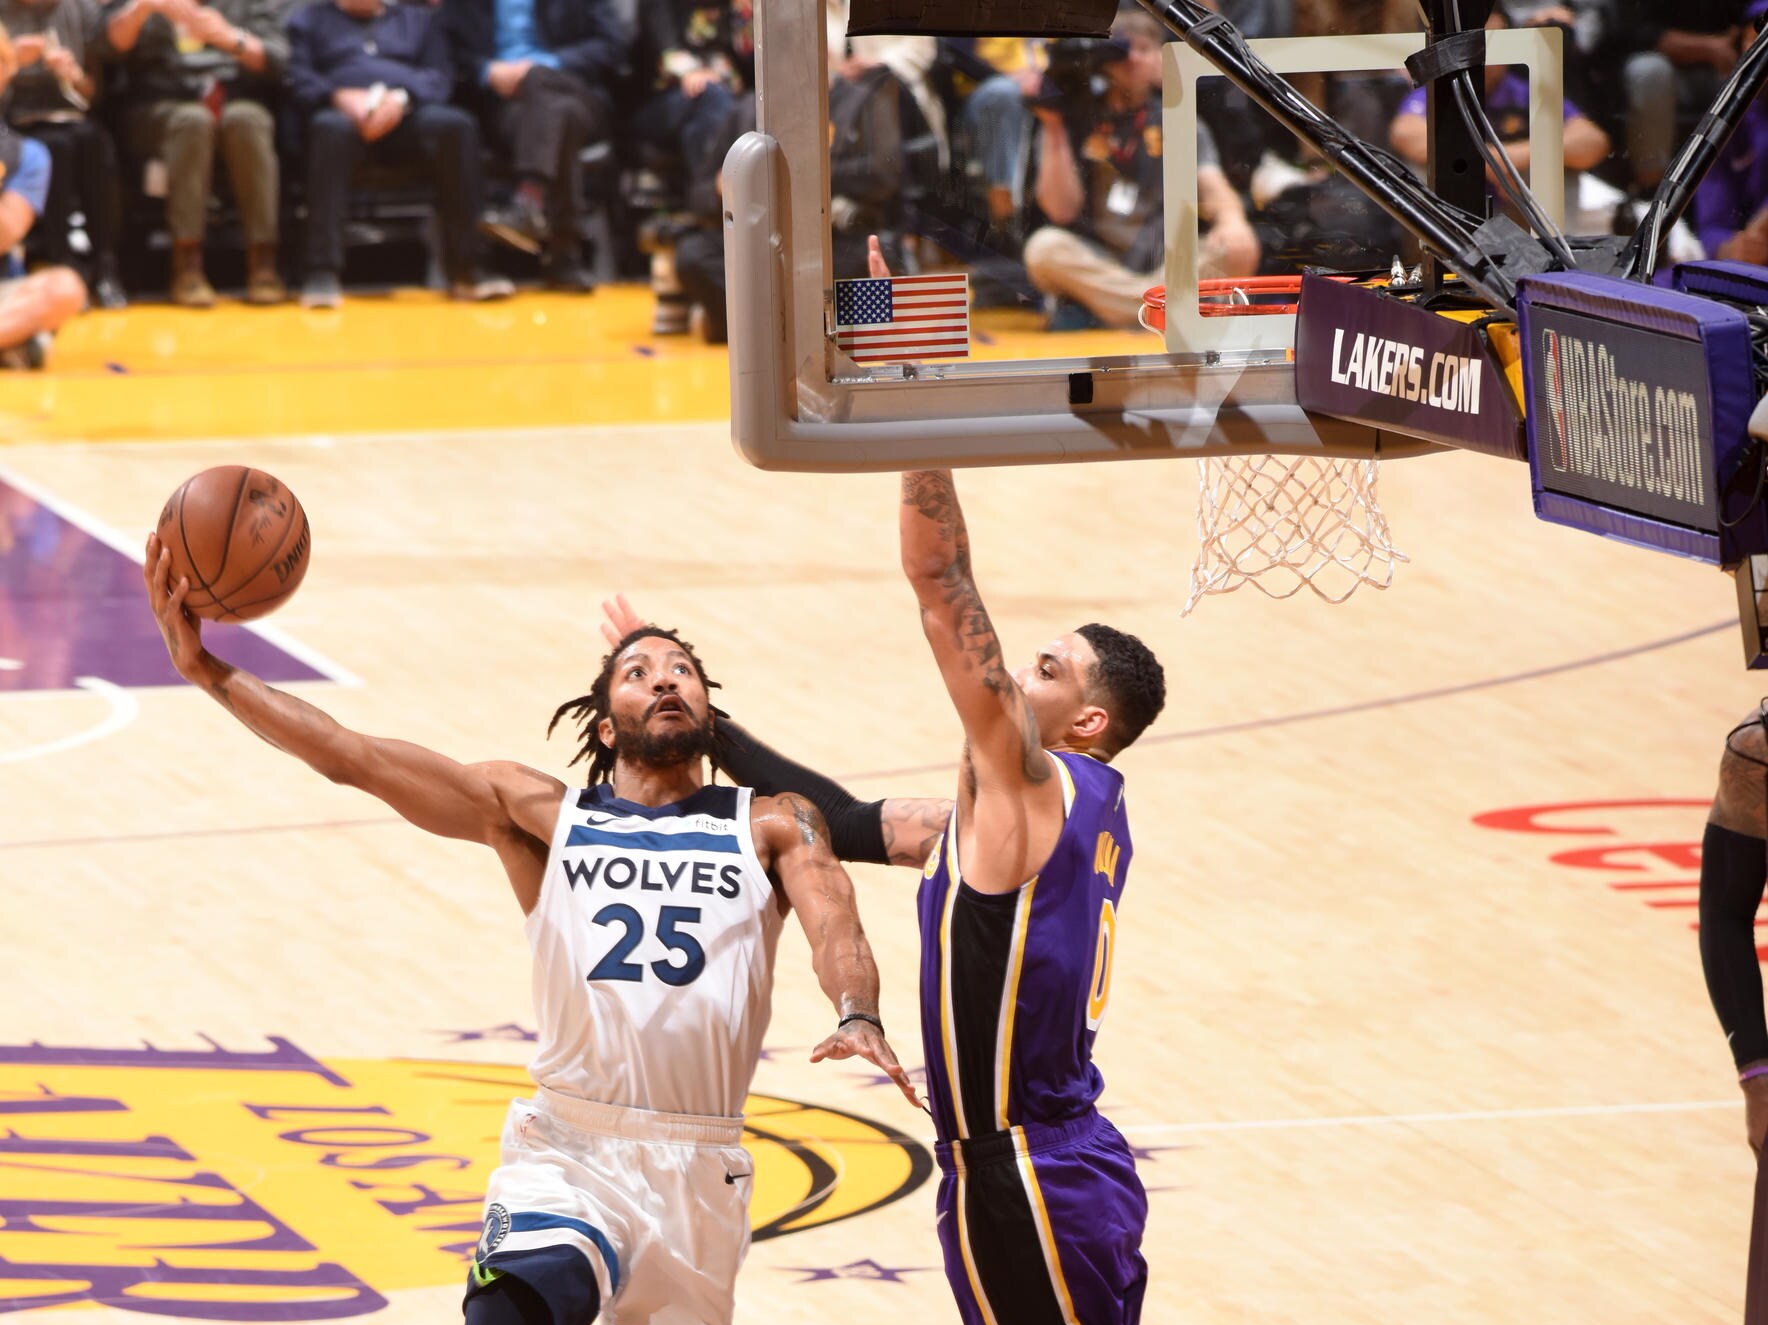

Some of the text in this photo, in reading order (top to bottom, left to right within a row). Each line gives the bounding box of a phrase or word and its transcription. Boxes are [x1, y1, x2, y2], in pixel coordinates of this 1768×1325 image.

[1331, 328, 1482, 415] LAKERS.COM
[1561, 334, 1704, 506] NBAStore.com
[695, 817, 728, 831] fitbit
[562, 856, 743, 899] WOLVES
[586, 902, 706, 987] 25
